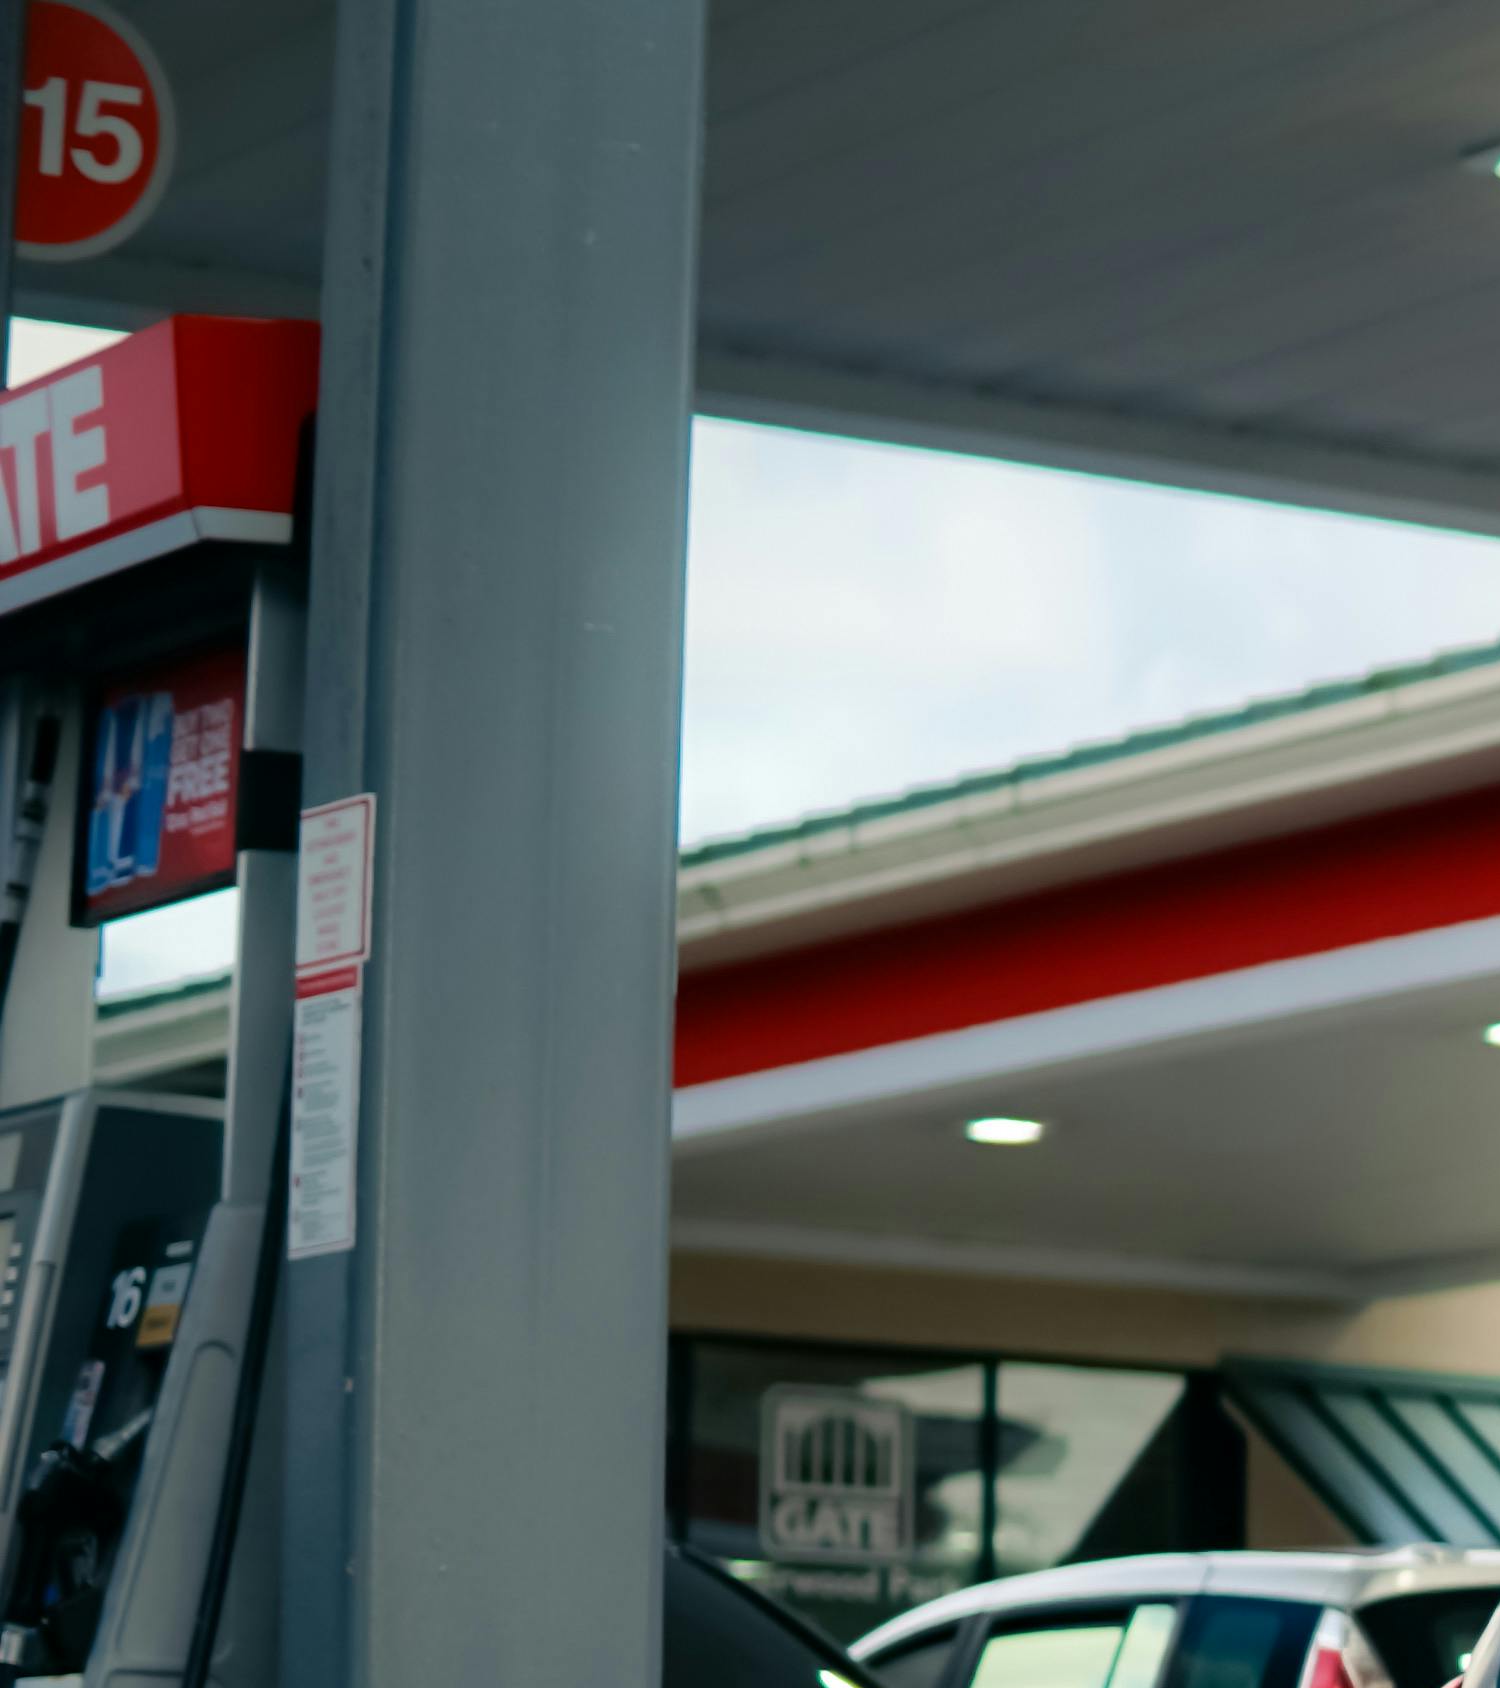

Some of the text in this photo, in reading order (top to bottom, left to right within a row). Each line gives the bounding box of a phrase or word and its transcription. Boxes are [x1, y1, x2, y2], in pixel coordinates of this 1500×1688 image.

[24, 76, 143, 185] 15
[107, 1266, 146, 1330] 16
[772, 1500, 898, 1549] GATE
